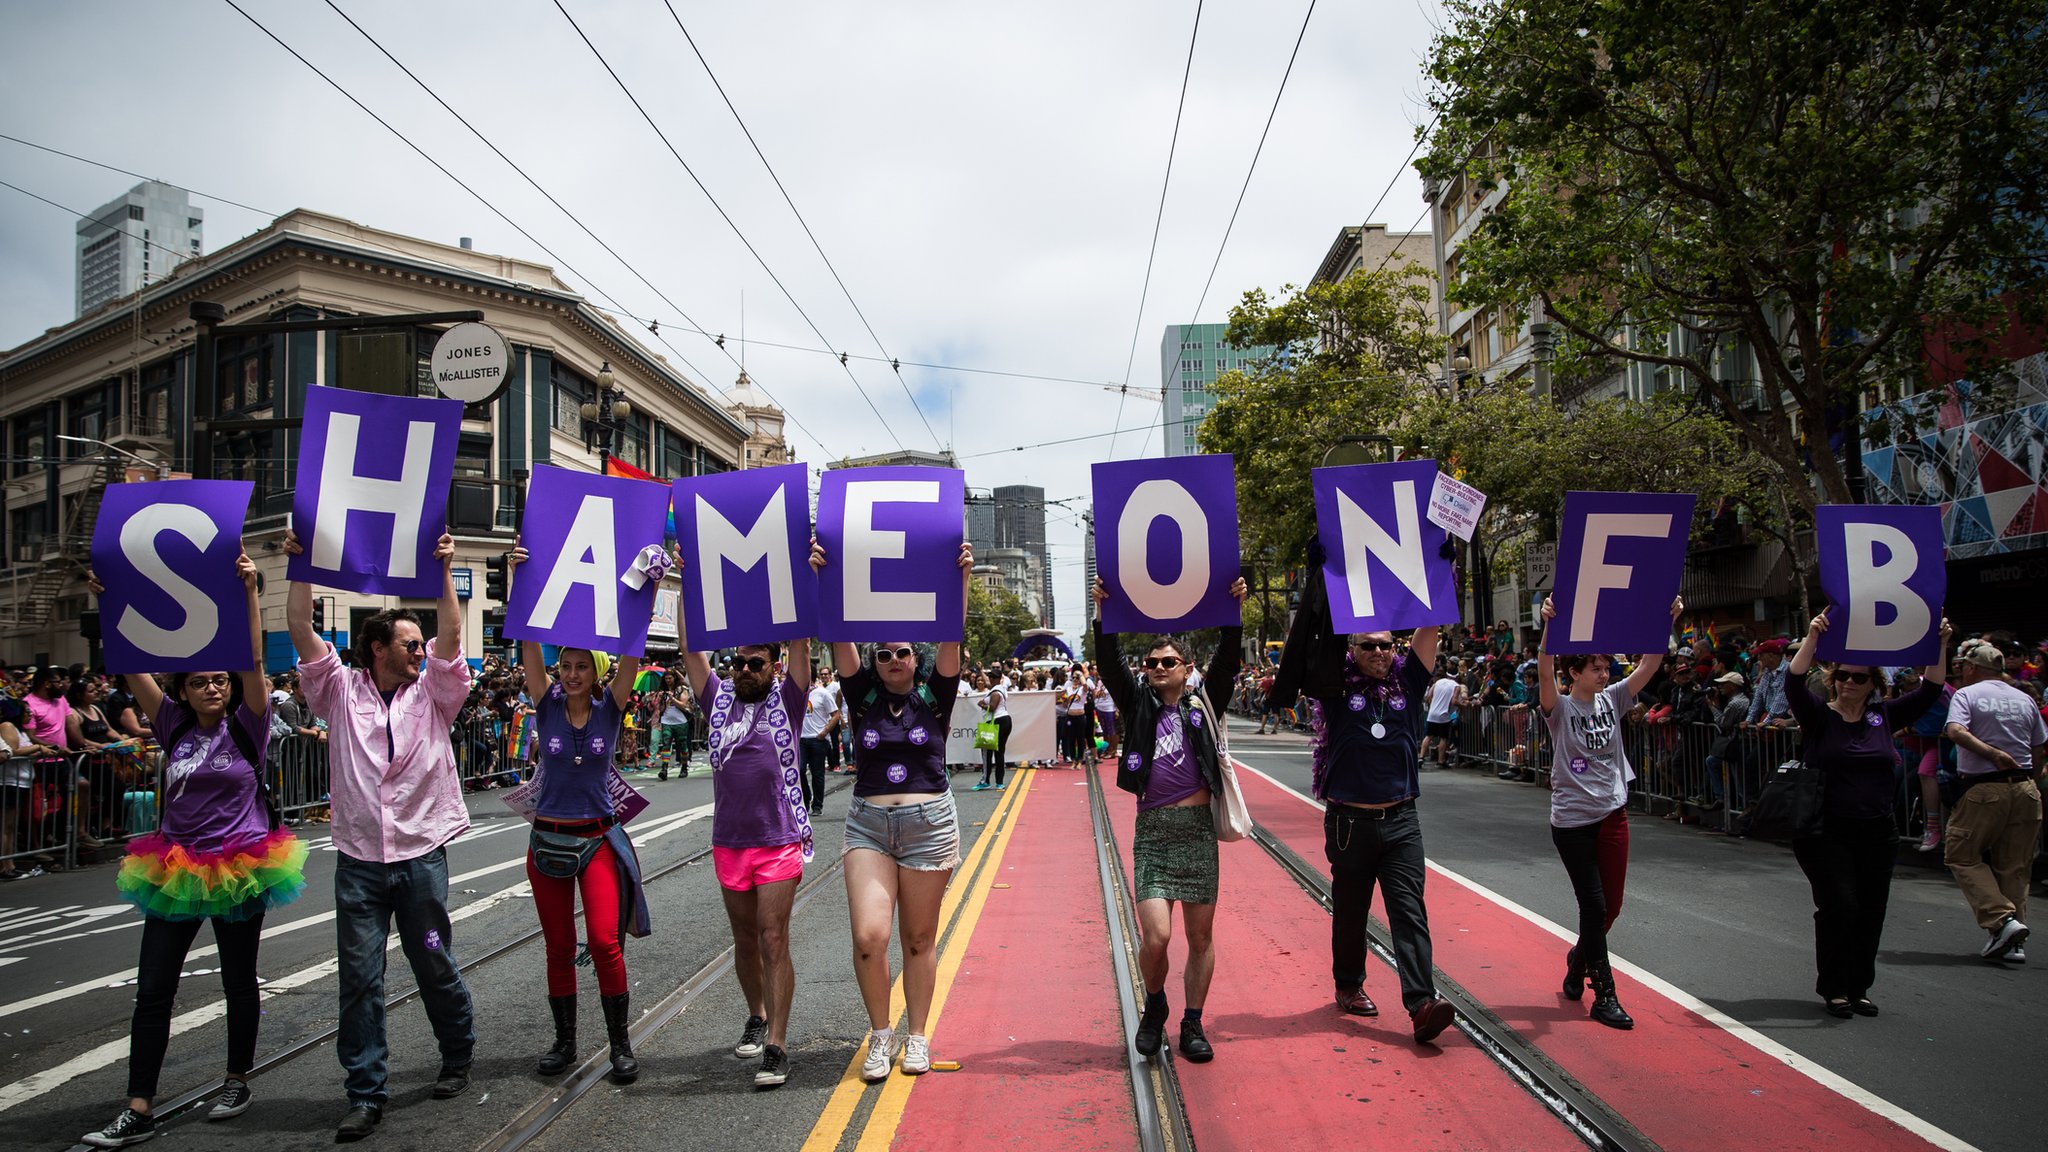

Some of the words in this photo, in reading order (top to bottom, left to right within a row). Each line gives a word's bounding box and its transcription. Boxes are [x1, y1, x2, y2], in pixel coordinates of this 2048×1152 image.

[439, 366, 500, 382] McALLISTER
[446, 345, 492, 360] JONES
[311, 412, 435, 578] H
[1438, 473, 1462, 490] FACEBOOK
[117, 503, 218, 658] S
[527, 495, 620, 638] A
[696, 483, 797, 631] M
[843, 481, 939, 621] E
[1118, 480, 1210, 619] O
[1337, 480, 1431, 617] N
[1528, 546, 1553, 555] STOP
[1532, 564, 1551, 572] RED
[1570, 514, 1672, 641] F
[1844, 523, 1930, 650] B
[1586, 731, 1610, 750] GAY
[1591, 708, 1616, 730] NOT
[502, 786, 528, 802] FACEBOOK
